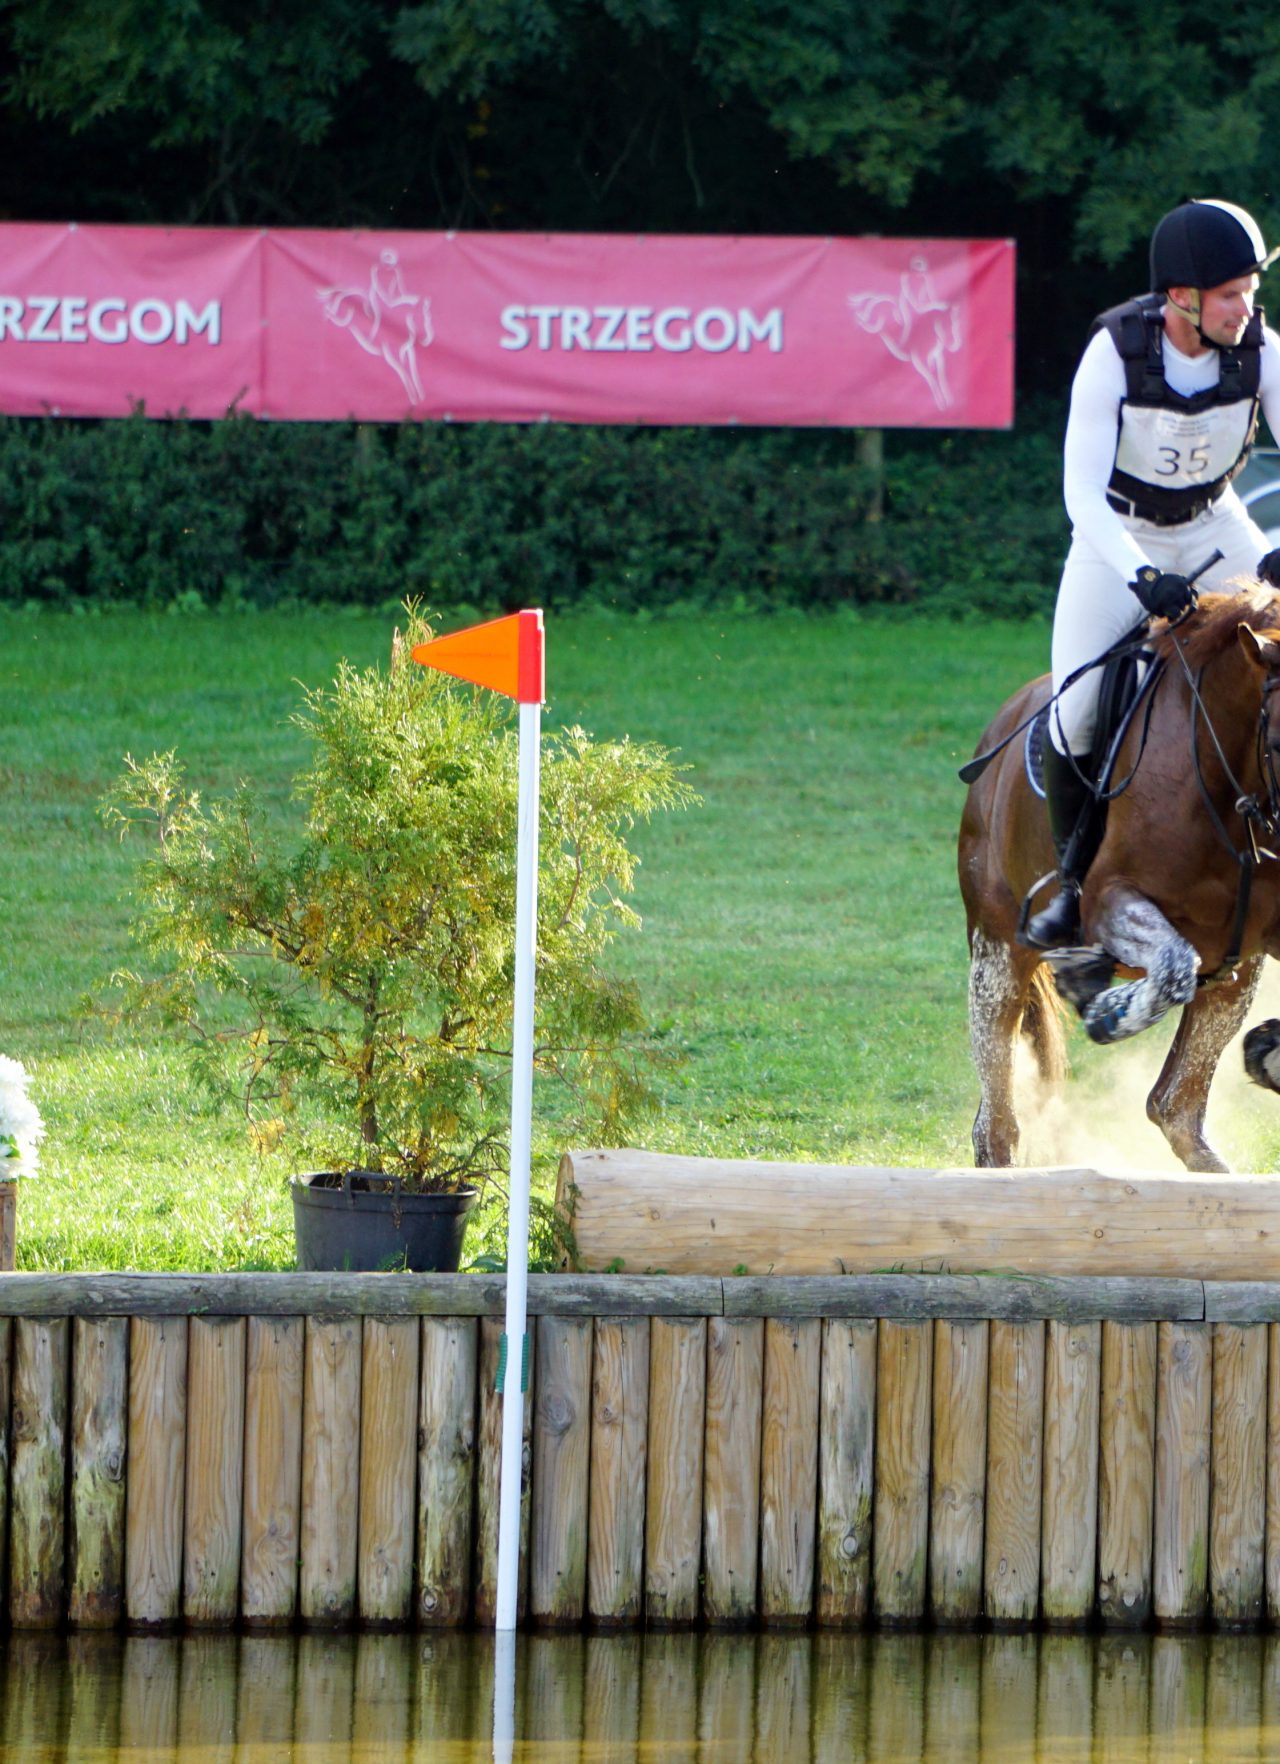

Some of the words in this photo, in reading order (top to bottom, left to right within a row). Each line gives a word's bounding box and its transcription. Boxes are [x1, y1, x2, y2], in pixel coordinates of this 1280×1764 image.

[0, 295, 222, 345] RZEGOM
[499, 303, 783, 353] STRZEGOM
[1154, 443, 1212, 477] 35
